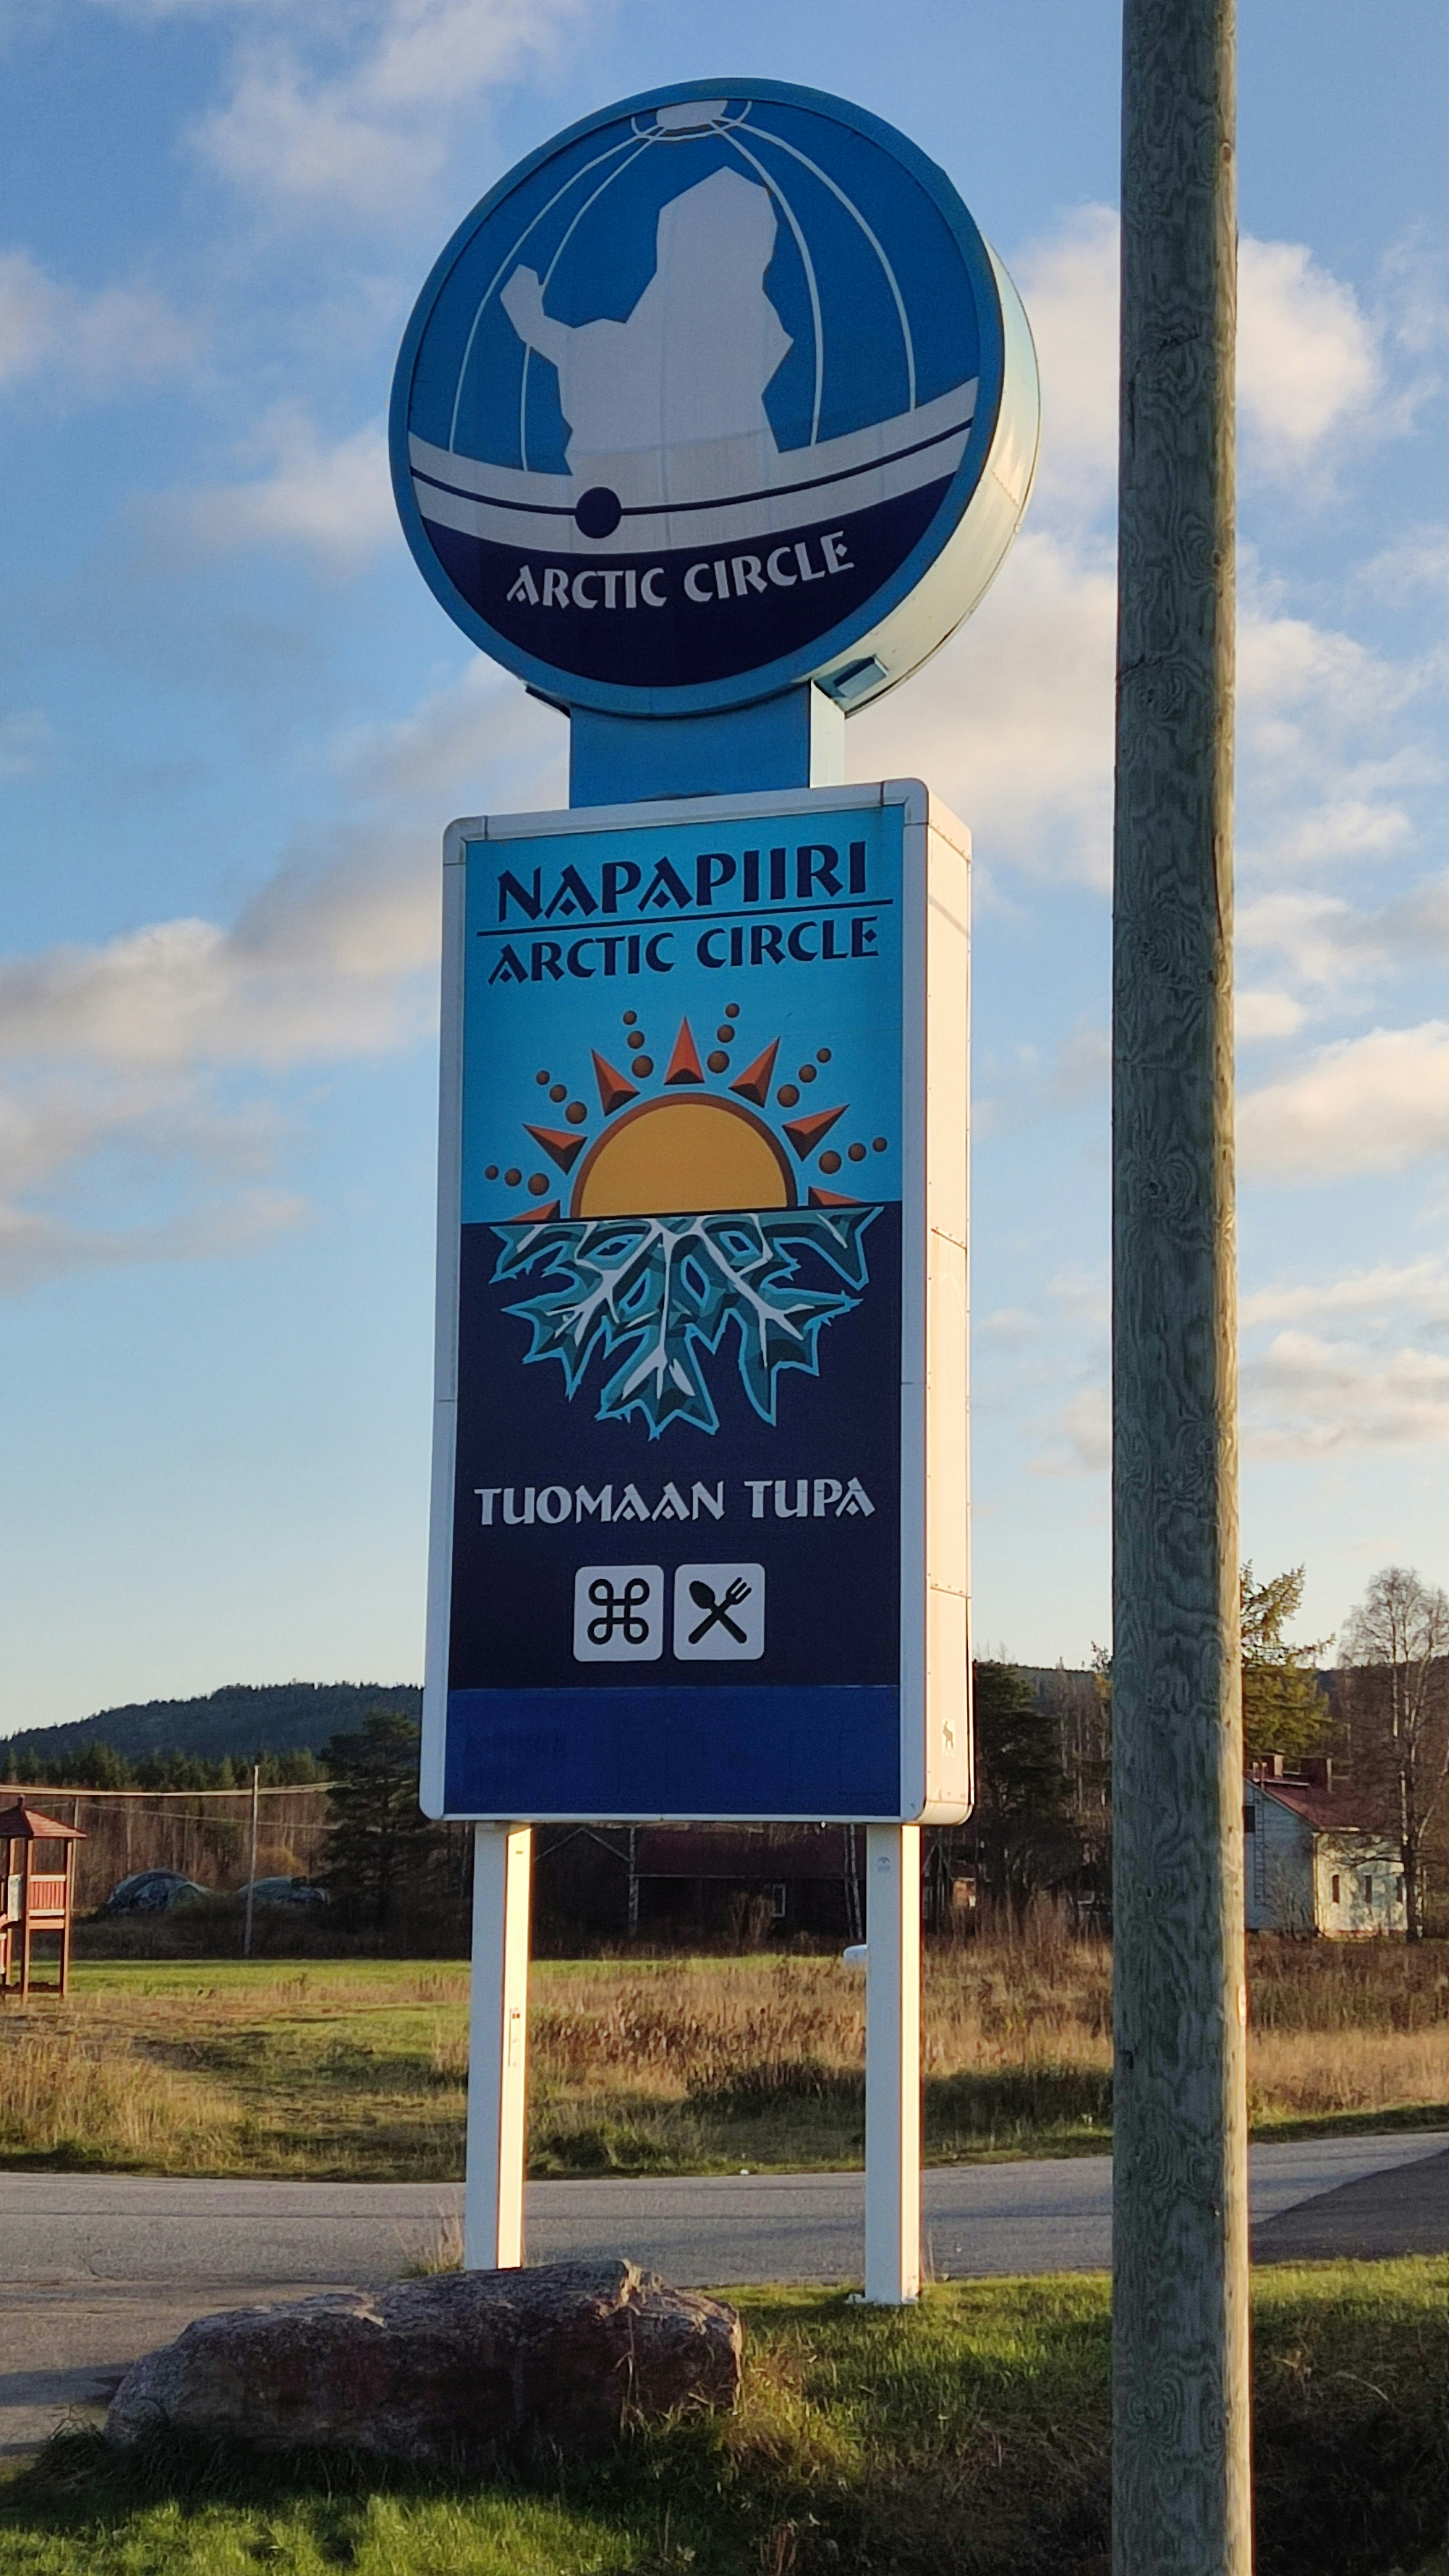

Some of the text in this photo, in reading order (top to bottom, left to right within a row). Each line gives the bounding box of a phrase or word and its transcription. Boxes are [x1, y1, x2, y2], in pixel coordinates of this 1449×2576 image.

[507, 531, 854, 609] ARCTIC CIRCLE
[498, 840, 866, 922] NAPAPIIRI
[488, 916, 878, 985] ARCTIC CIRCLE
[474, 1477, 875, 1525] TUOMAAN TUPA
